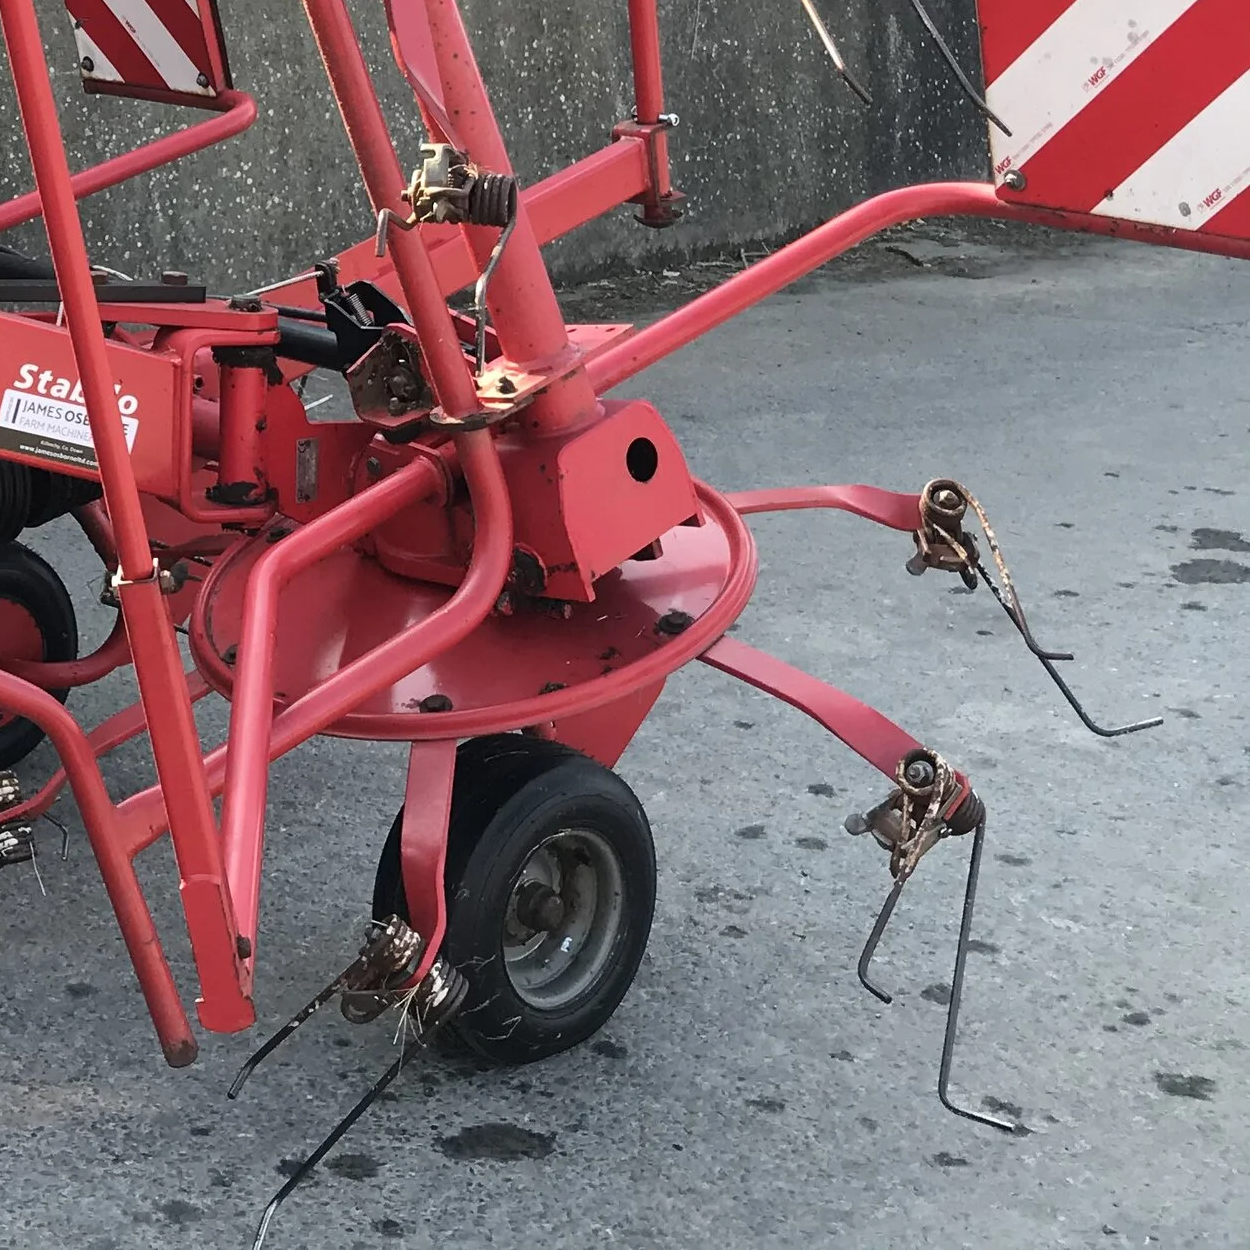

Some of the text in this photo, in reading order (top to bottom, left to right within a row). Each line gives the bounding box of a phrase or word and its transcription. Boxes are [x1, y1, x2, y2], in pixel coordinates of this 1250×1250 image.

[1088, 66, 1107, 88] WGF
[995, 155, 1013, 175] WGF
[1203, 188, 1223, 208] WGF
[13, 363, 139, 415] Stabo
[22, 400, 62, 420] JAMES
[19, 416, 93, 441] FARM MACHINE
